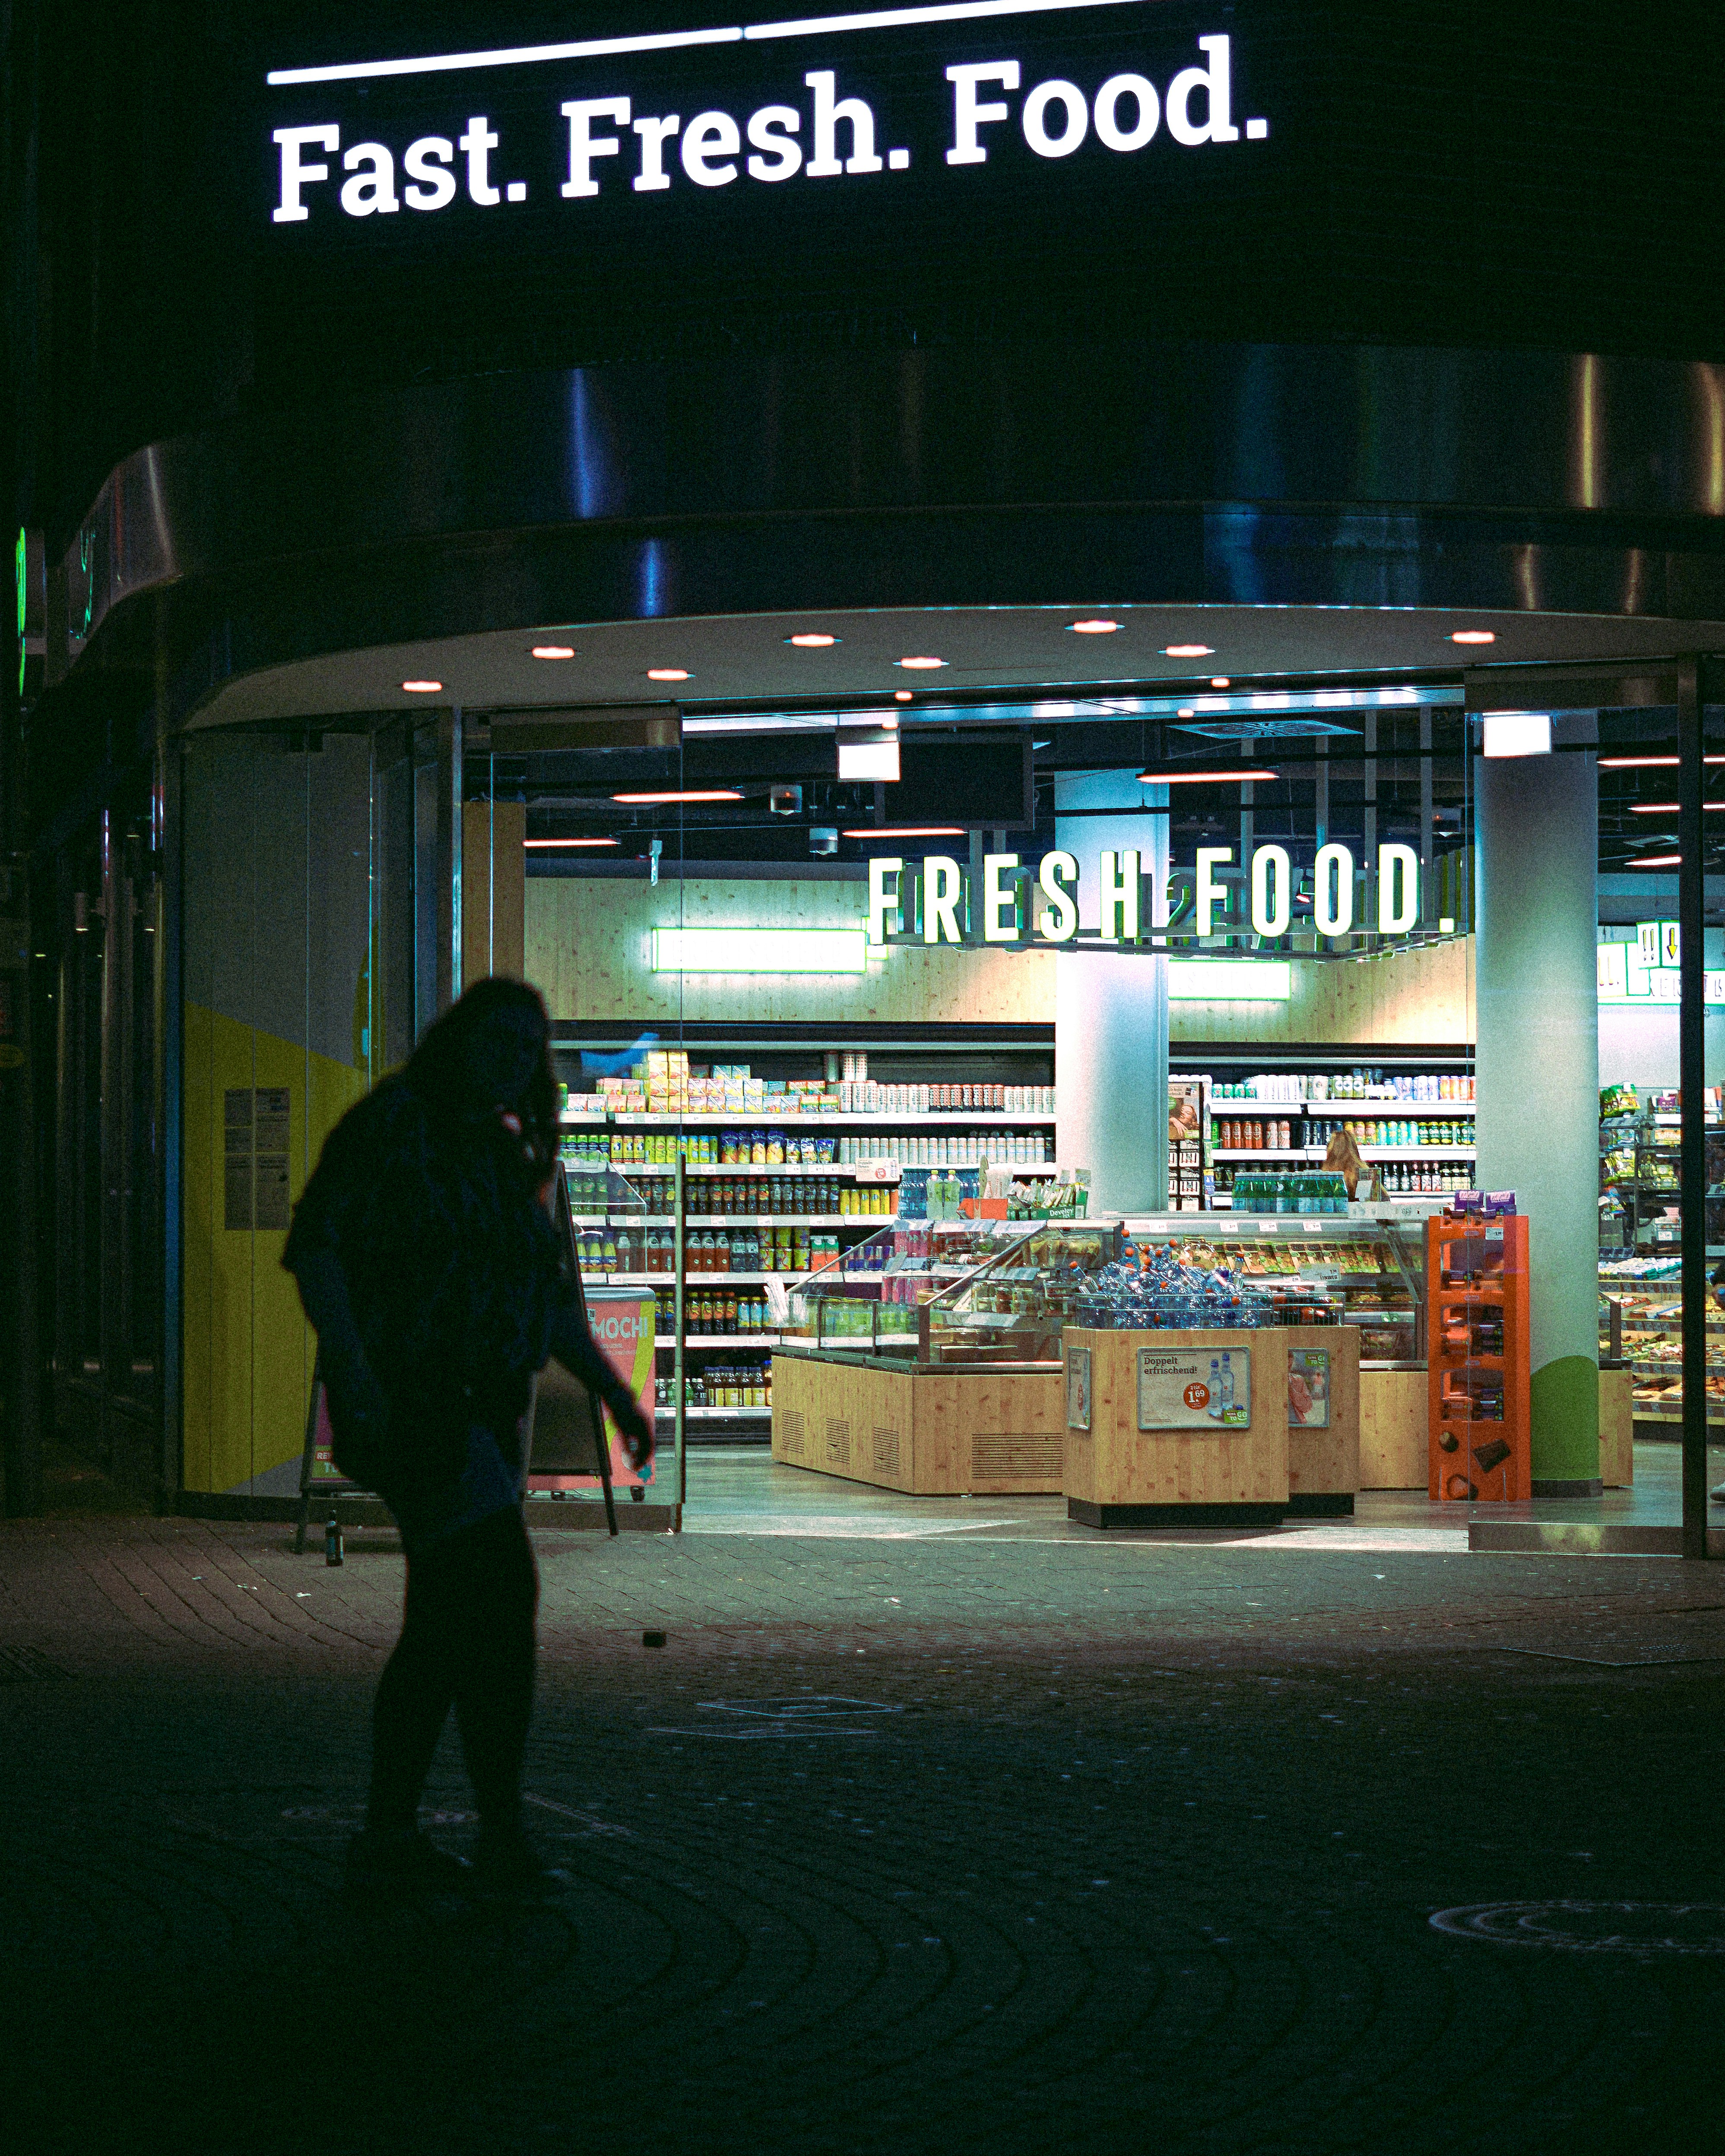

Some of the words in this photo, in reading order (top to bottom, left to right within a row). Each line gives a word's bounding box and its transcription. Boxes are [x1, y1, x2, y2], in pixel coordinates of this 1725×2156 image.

[273, 114, 526, 222] Fast.
[561, 70, 910, 197] Fresh.
[946, 34, 1268, 165] Food.
[867, 850, 1138, 944] FRESH
[1196, 844, 1454, 937] FOOD.
[1050, 1208, 1073, 1217] Develey
[592, 1316, 647, 1339] MOCHI
[1144, 1357, 1178, 1367] Doppelt
[1144, 1366, 1197, 1374] erfrischend!
